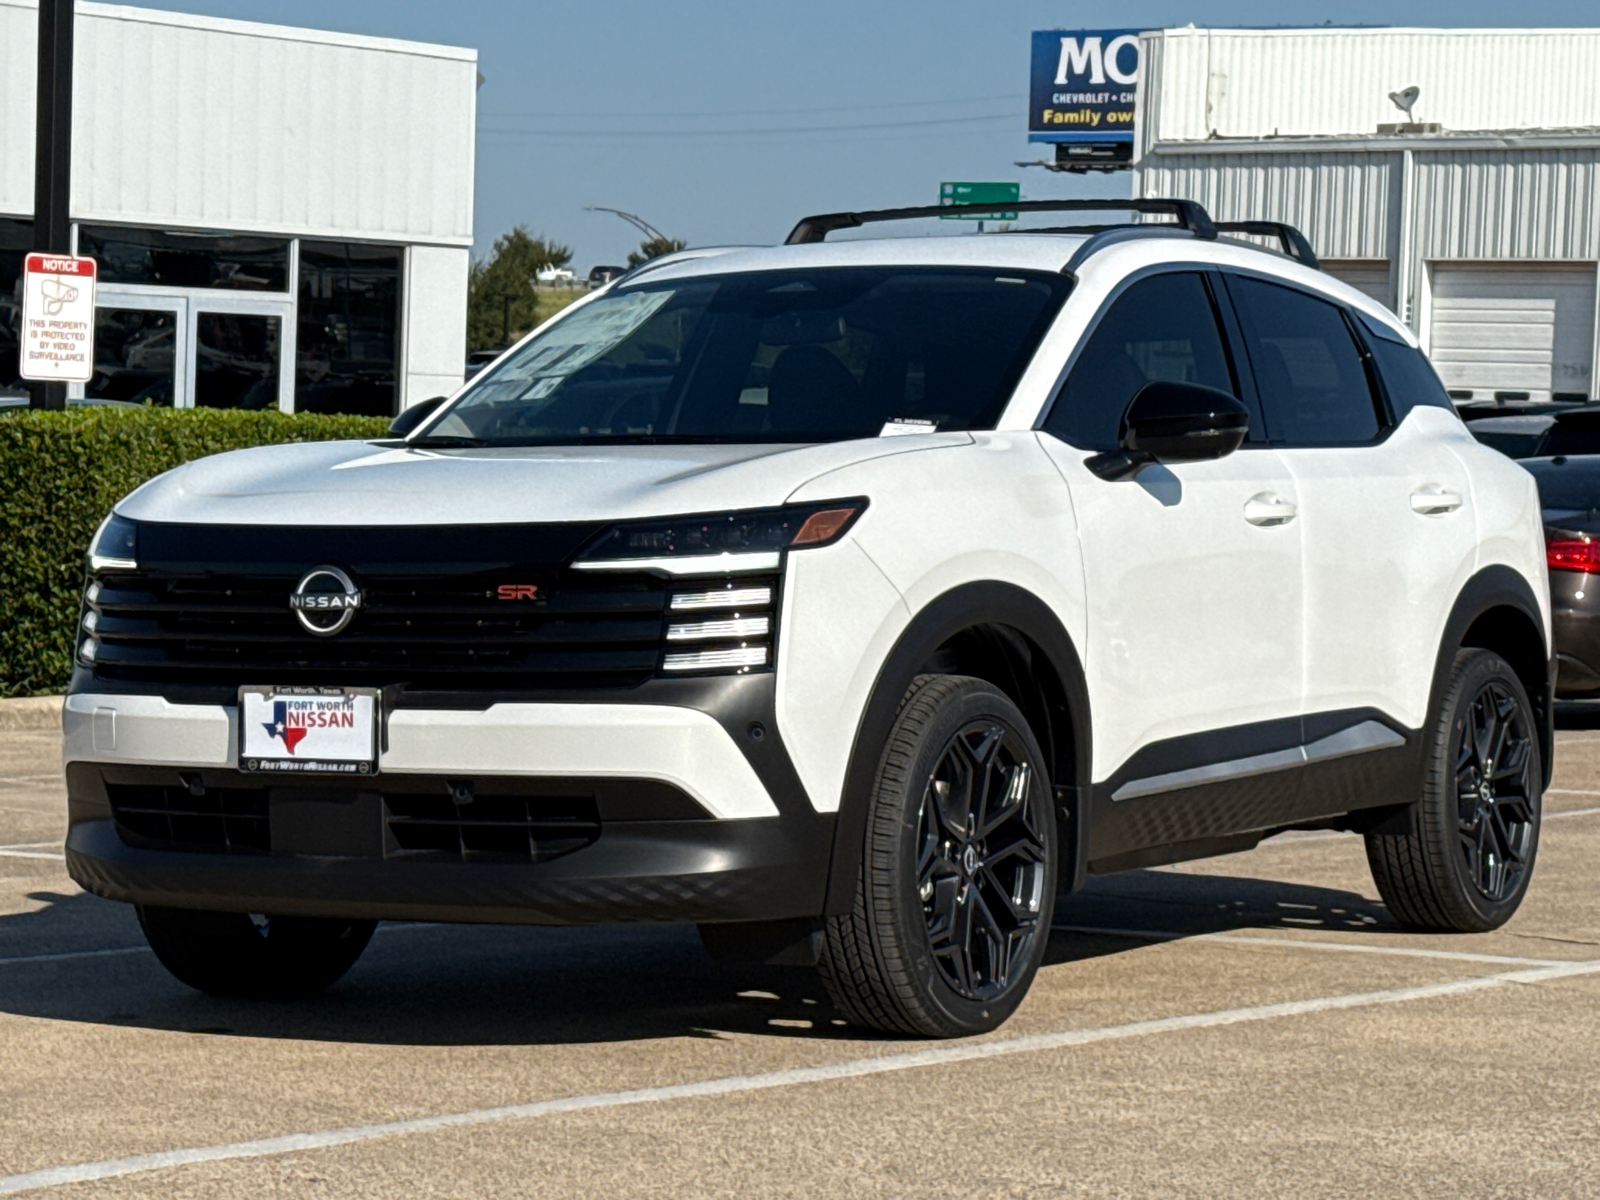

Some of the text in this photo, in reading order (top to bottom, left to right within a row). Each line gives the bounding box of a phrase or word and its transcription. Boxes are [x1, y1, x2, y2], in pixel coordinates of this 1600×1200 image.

[1054, 35, 1139, 85] MO
[1052, 92, 1136, 104] CHEVROLET CH
[1043, 109, 1135, 127] Family ow
[42, 259, 80, 273] NOTICE
[29, 319, 88, 330] THIS PROPERTY
[31, 330, 86, 341] IS PROTECTED
[39, 341, 76, 351] BY VIDEO
[29, 350, 85, 362] SURVEILLANCE
[498, 584, 538, 600] SR
[290, 594, 360, 608] NISSAN
[288, 701, 354, 711] FORT WORTH
[288, 711, 354, 728] NISSAN
